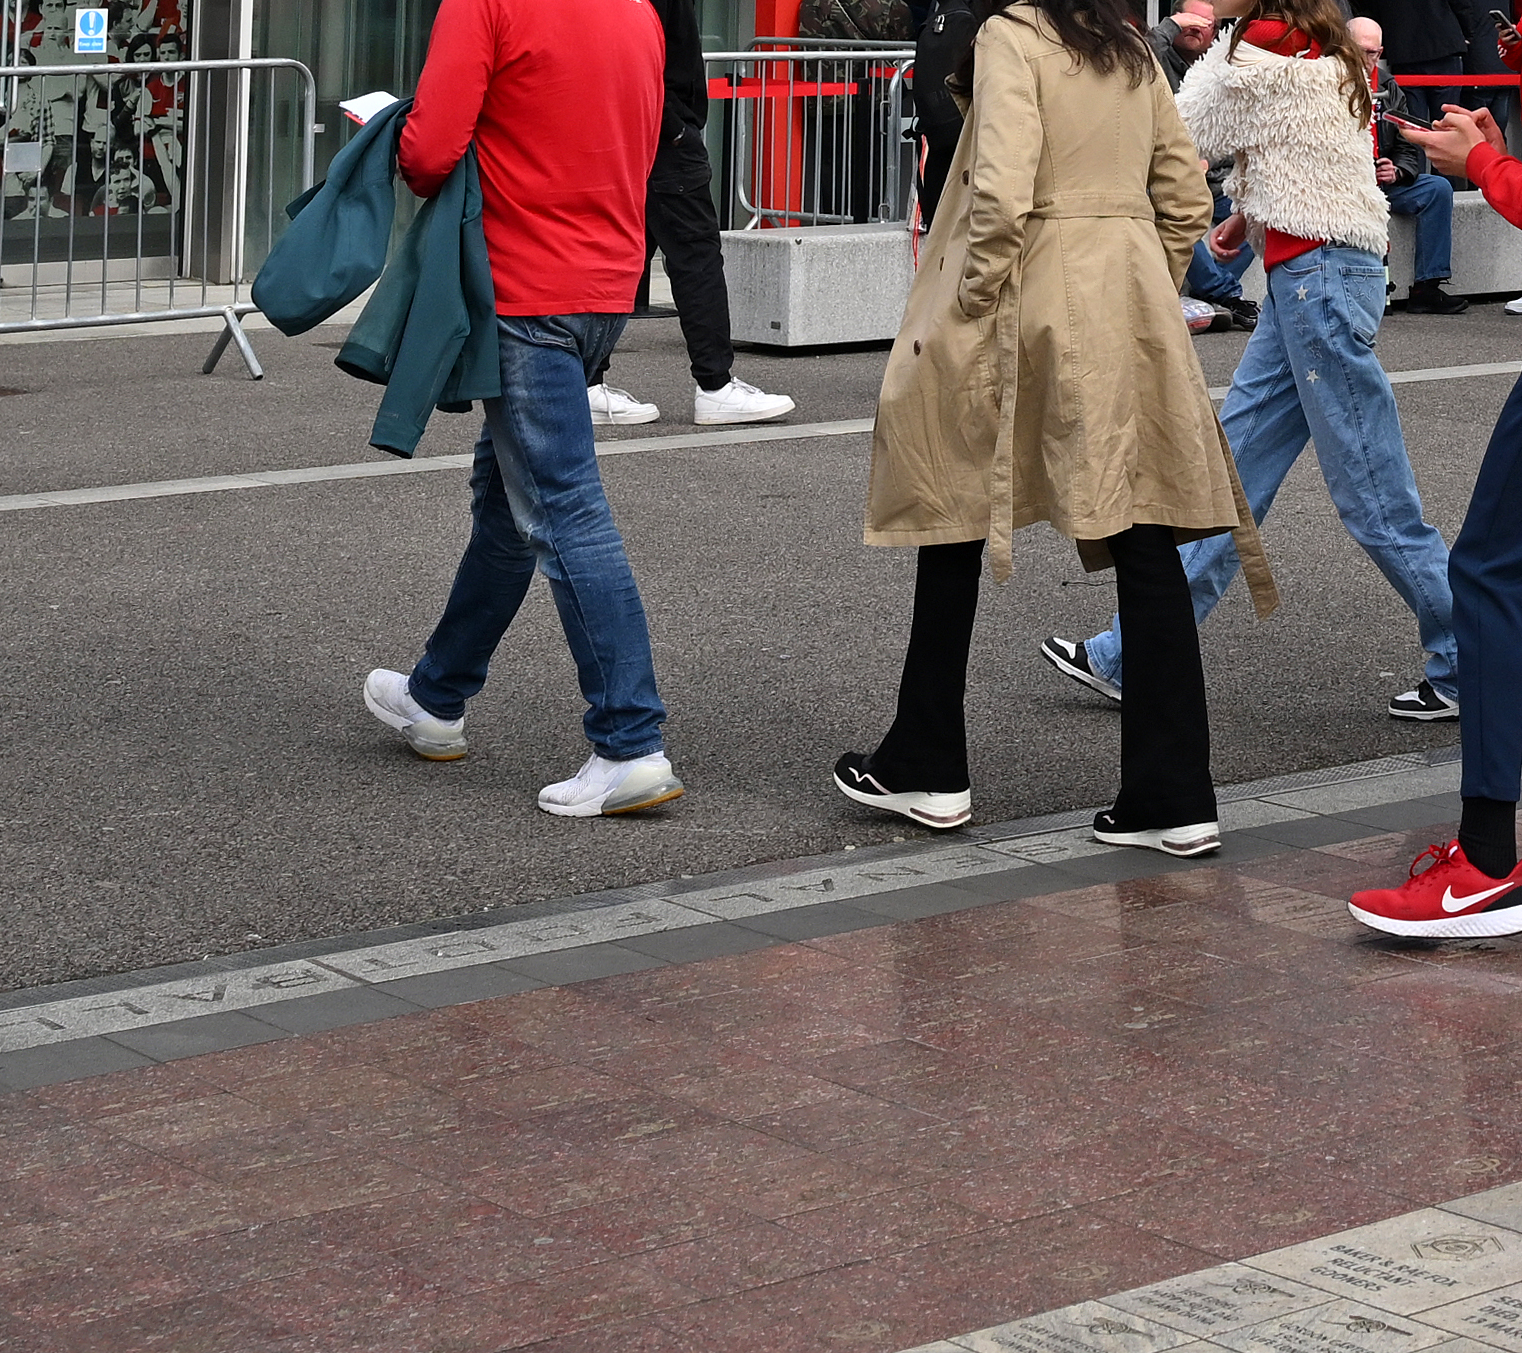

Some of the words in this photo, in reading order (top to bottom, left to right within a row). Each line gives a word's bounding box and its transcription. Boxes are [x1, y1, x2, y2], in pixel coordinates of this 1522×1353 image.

[1304, 1265, 1391, 1292] GOONERS
[1324, 1257, 1420, 1287] RELUCTANT
[1326, 1244, 1386, 1262] BAKER
[1390, 1264, 1434, 1278] RAE
[1420, 1273, 1464, 1287] FOX
